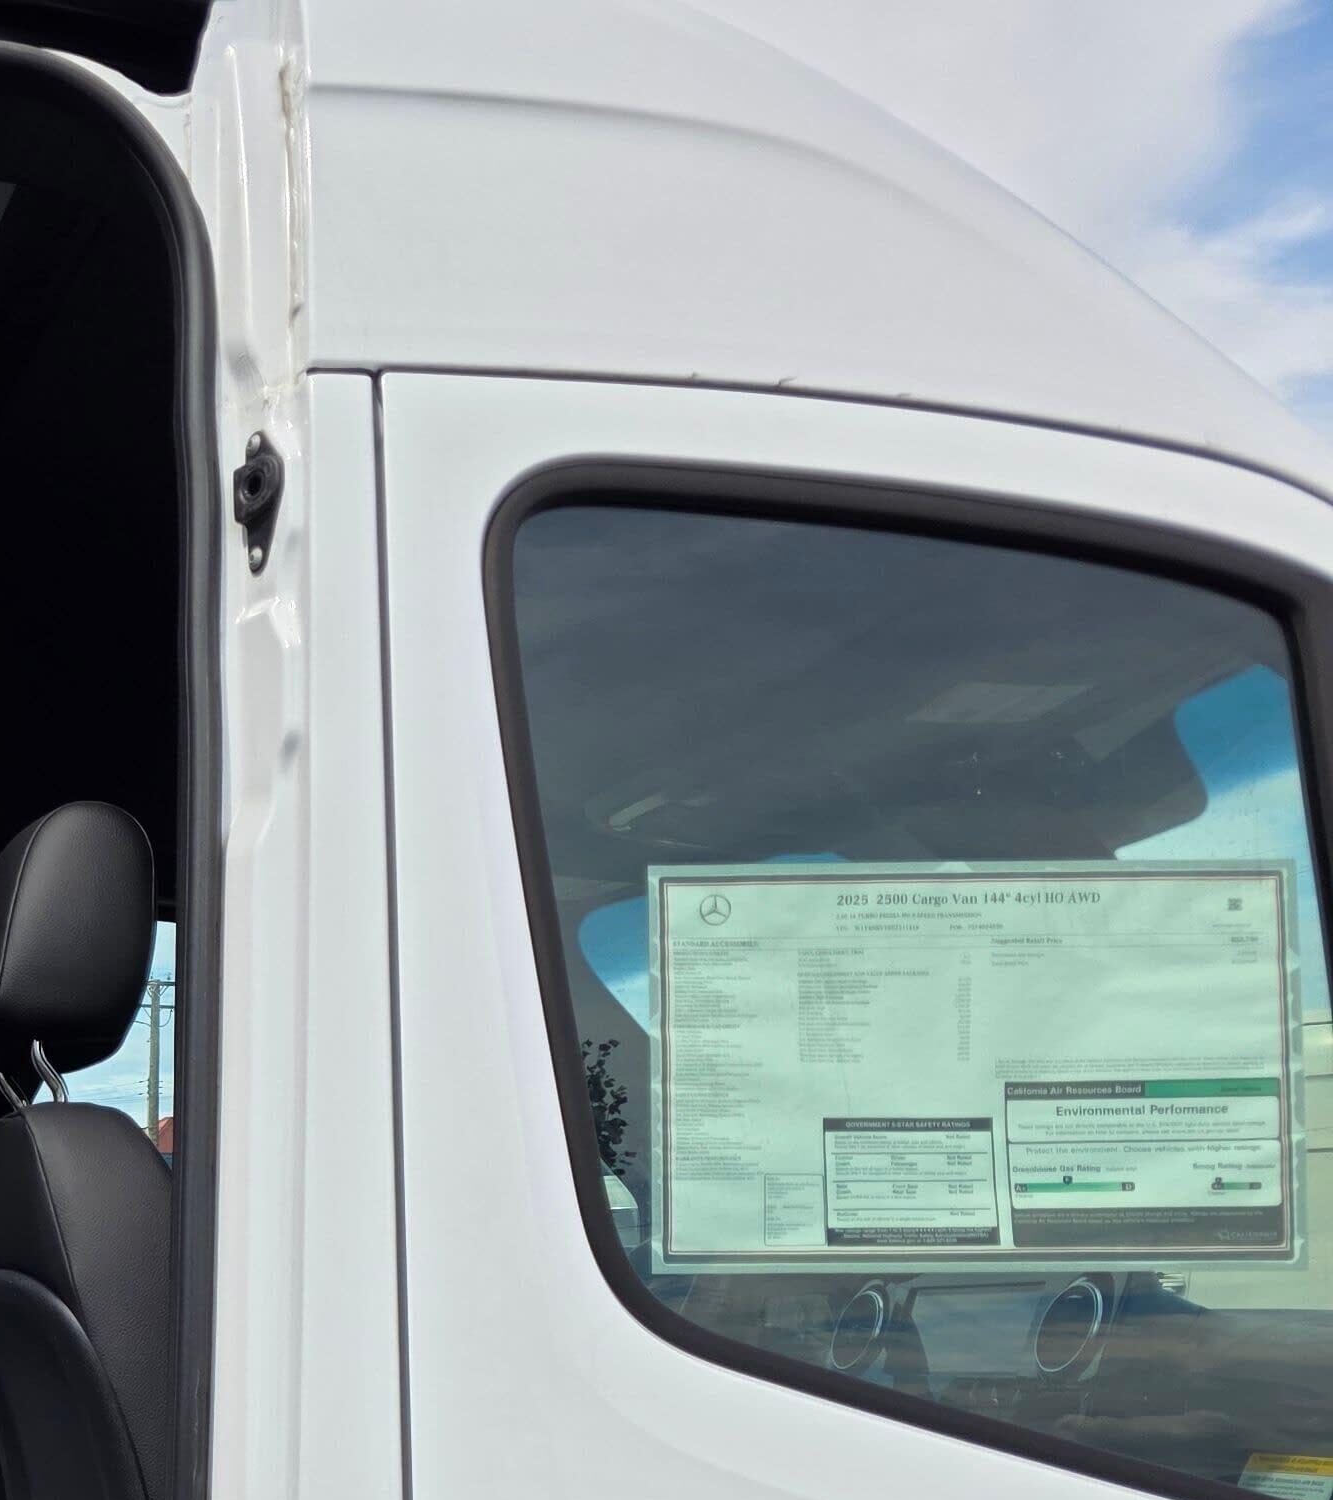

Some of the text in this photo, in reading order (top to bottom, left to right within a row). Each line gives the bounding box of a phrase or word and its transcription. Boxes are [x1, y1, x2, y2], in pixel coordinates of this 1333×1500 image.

[836, 893, 869, 907] 2025
[876, 893, 909, 905] 2500
[912, 893, 948, 907] Cargo
[952, 893, 978, 905] Van
[1015, 891, 1041, 906] 4cyl
[1045, 891, 1064, 904] HO
[1067, 891, 1101, 904] AWD
[1007, 1083, 1142, 1097] California Air Resources Board
[1056, 1103, 1229, 1117] Environmental Performance
